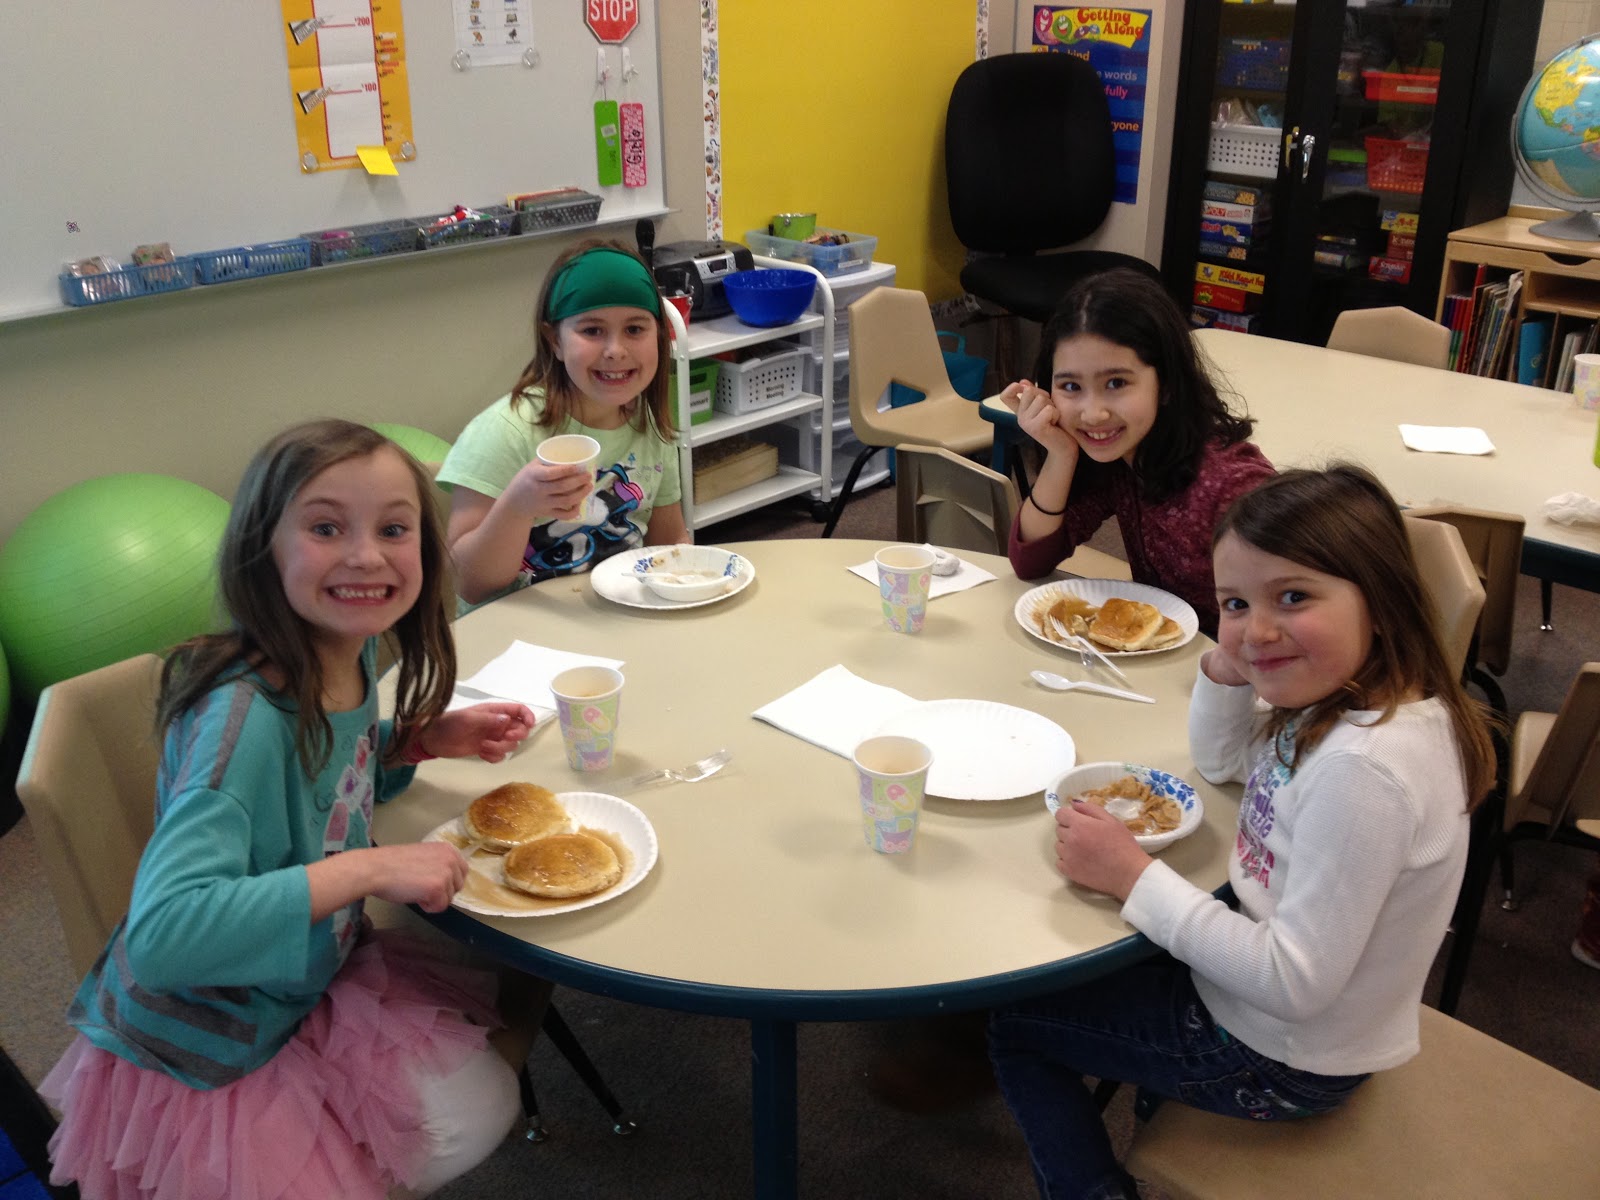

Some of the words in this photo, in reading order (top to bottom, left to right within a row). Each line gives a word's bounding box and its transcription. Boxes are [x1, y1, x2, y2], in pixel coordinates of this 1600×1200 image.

[590, 0, 635, 21] STOP
[1077, 7, 1131, 25] Getting
[1103, 22, 1144, 39] Along
[1104, 69, 1138, 81] words
[1104, 84, 1128, 100] fully
